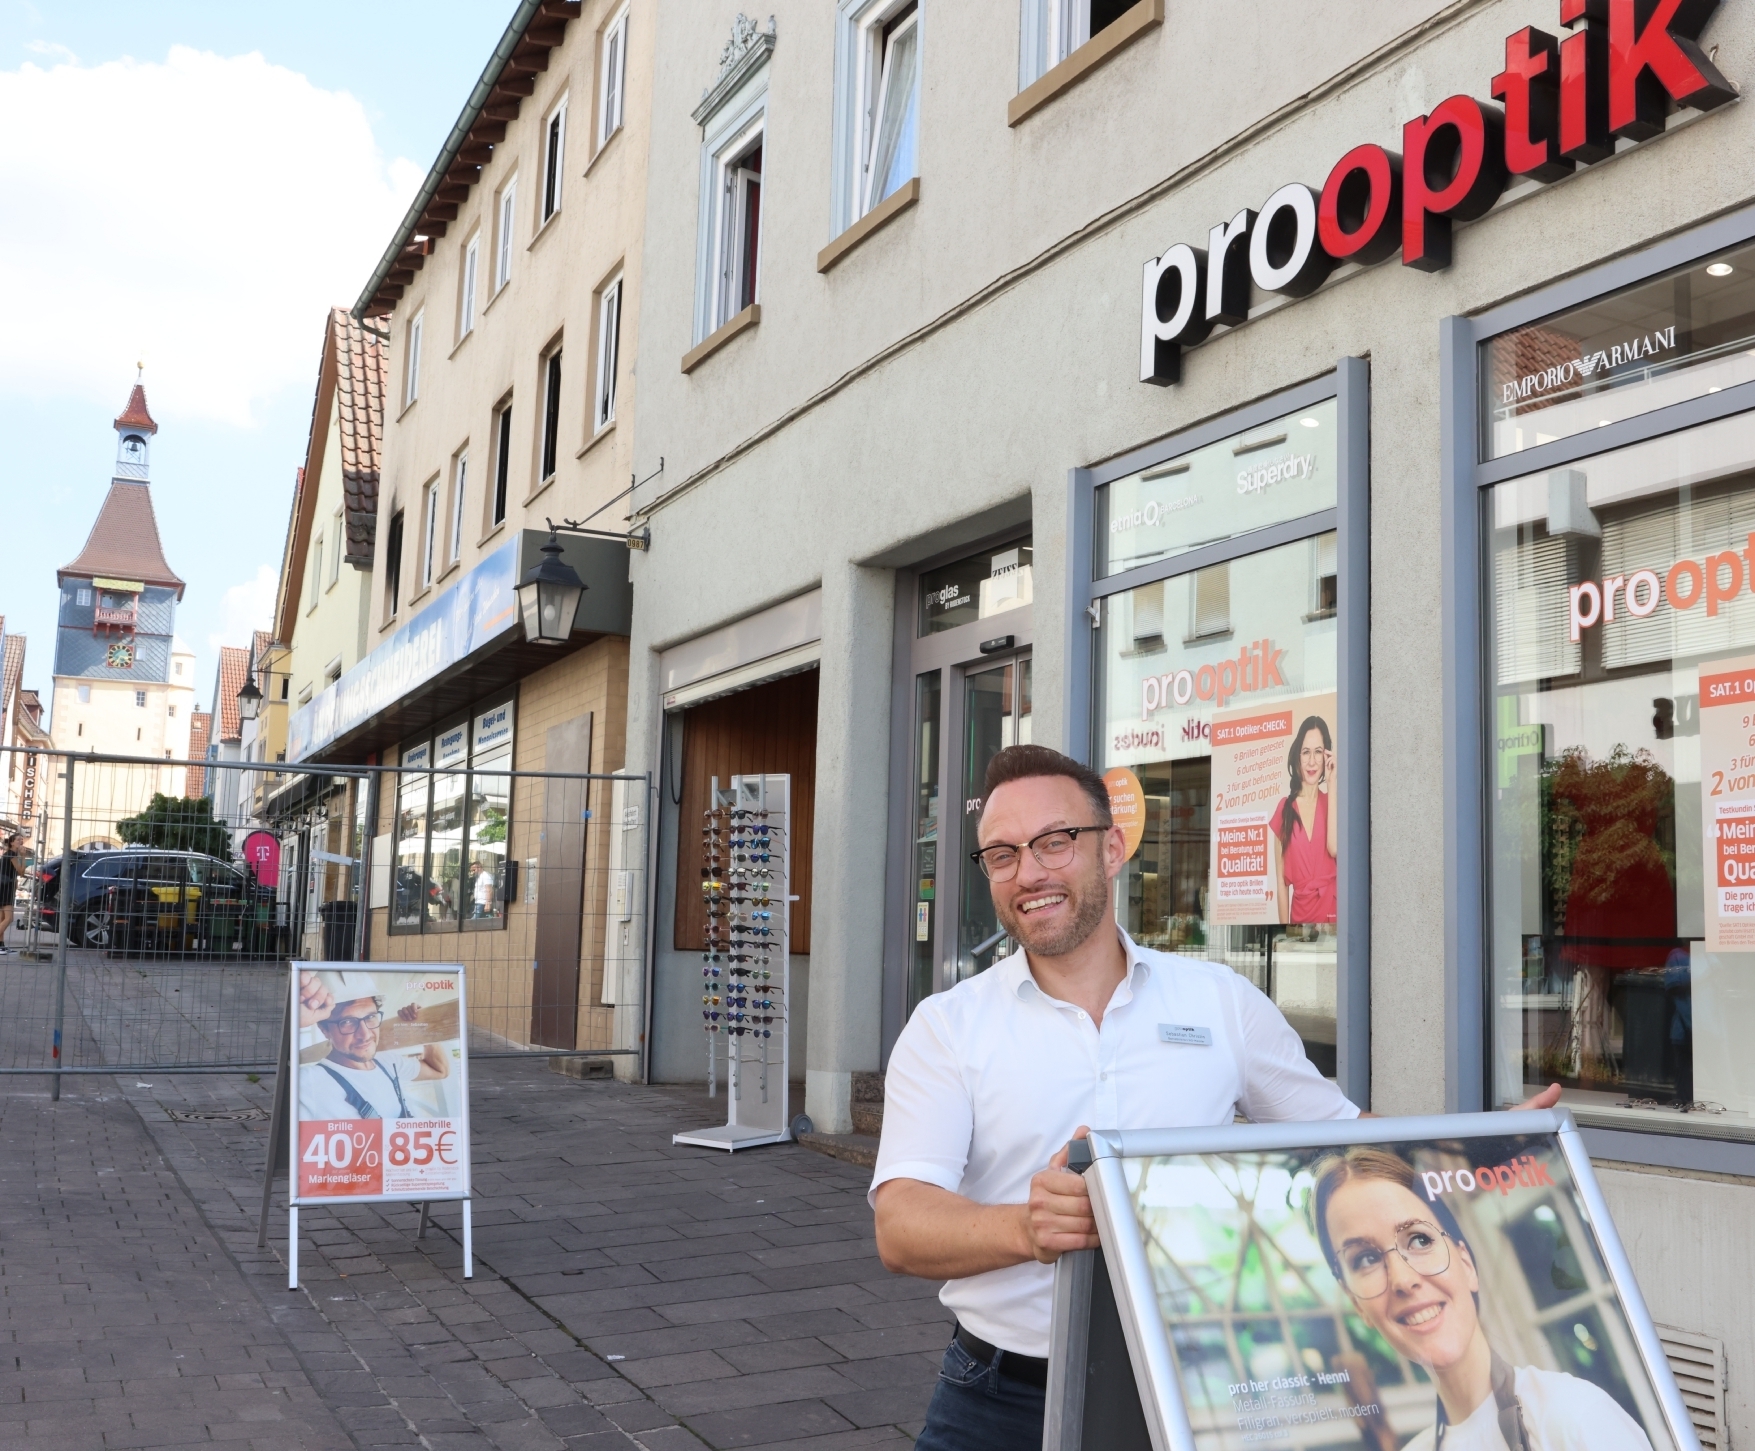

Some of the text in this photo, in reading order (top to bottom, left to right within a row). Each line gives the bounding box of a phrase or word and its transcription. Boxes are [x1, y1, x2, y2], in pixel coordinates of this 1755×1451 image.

[1502, 325, 1676, 404] EMPORIO ARMANI
[1110, 507, 1142, 533] etnia
[627, 538, 644, 549] 0987
[1709, 680, 1741, 698] SAT.1
[1216, 719, 1287, 740] SAT.1 Optiker-CHECK:
[1742, 715, 1750, 729] 9
[1233, 739, 1285, 763] 9 Brillen getestet
[1236, 754, 1284, 776] 6 durchgefallen
[1730, 757, 1738, 771] 3
[1226, 770, 1282, 794] 3 für gut befunden
[1710, 770, 1755, 796] 2 von
[1113, 793, 1135, 804] suchen
[1215, 792, 1224, 812] 2
[1224, 796, 1241, 809] von
[1241, 789, 1257, 806] pro
[1109, 803, 1138, 815] tärkung!
[1719, 804, 1753, 814] Testkundin
[1221, 828, 1264, 844] Meine Nr.1
[1221, 844, 1264, 855] bei Beratung und
[1723, 843, 1738, 855] bei
[1221, 854, 1264, 876] Qualität!
[1724, 890, 1754, 902] Die pro
[1723, 902, 1744, 914] trage
[327, 1121, 353, 1132] Brille
[395, 1119, 452, 1130] Sonnenbrille
[302, 1131, 379, 1170] 40%
[388, 1130, 458, 1167] 85€
[308, 1172, 372, 1184] Markengläser
[1228, 1383, 1249, 1397] pro
[1249, 1379, 1270, 1393] her
[1271, 1374, 1311, 1391] classic
[1316, 1369, 1351, 1386] Henni
[1232, 1392, 1317, 1414] Metall-Fassung
[1237, 1402, 1380, 1431] Filigran, verspielt, modern
